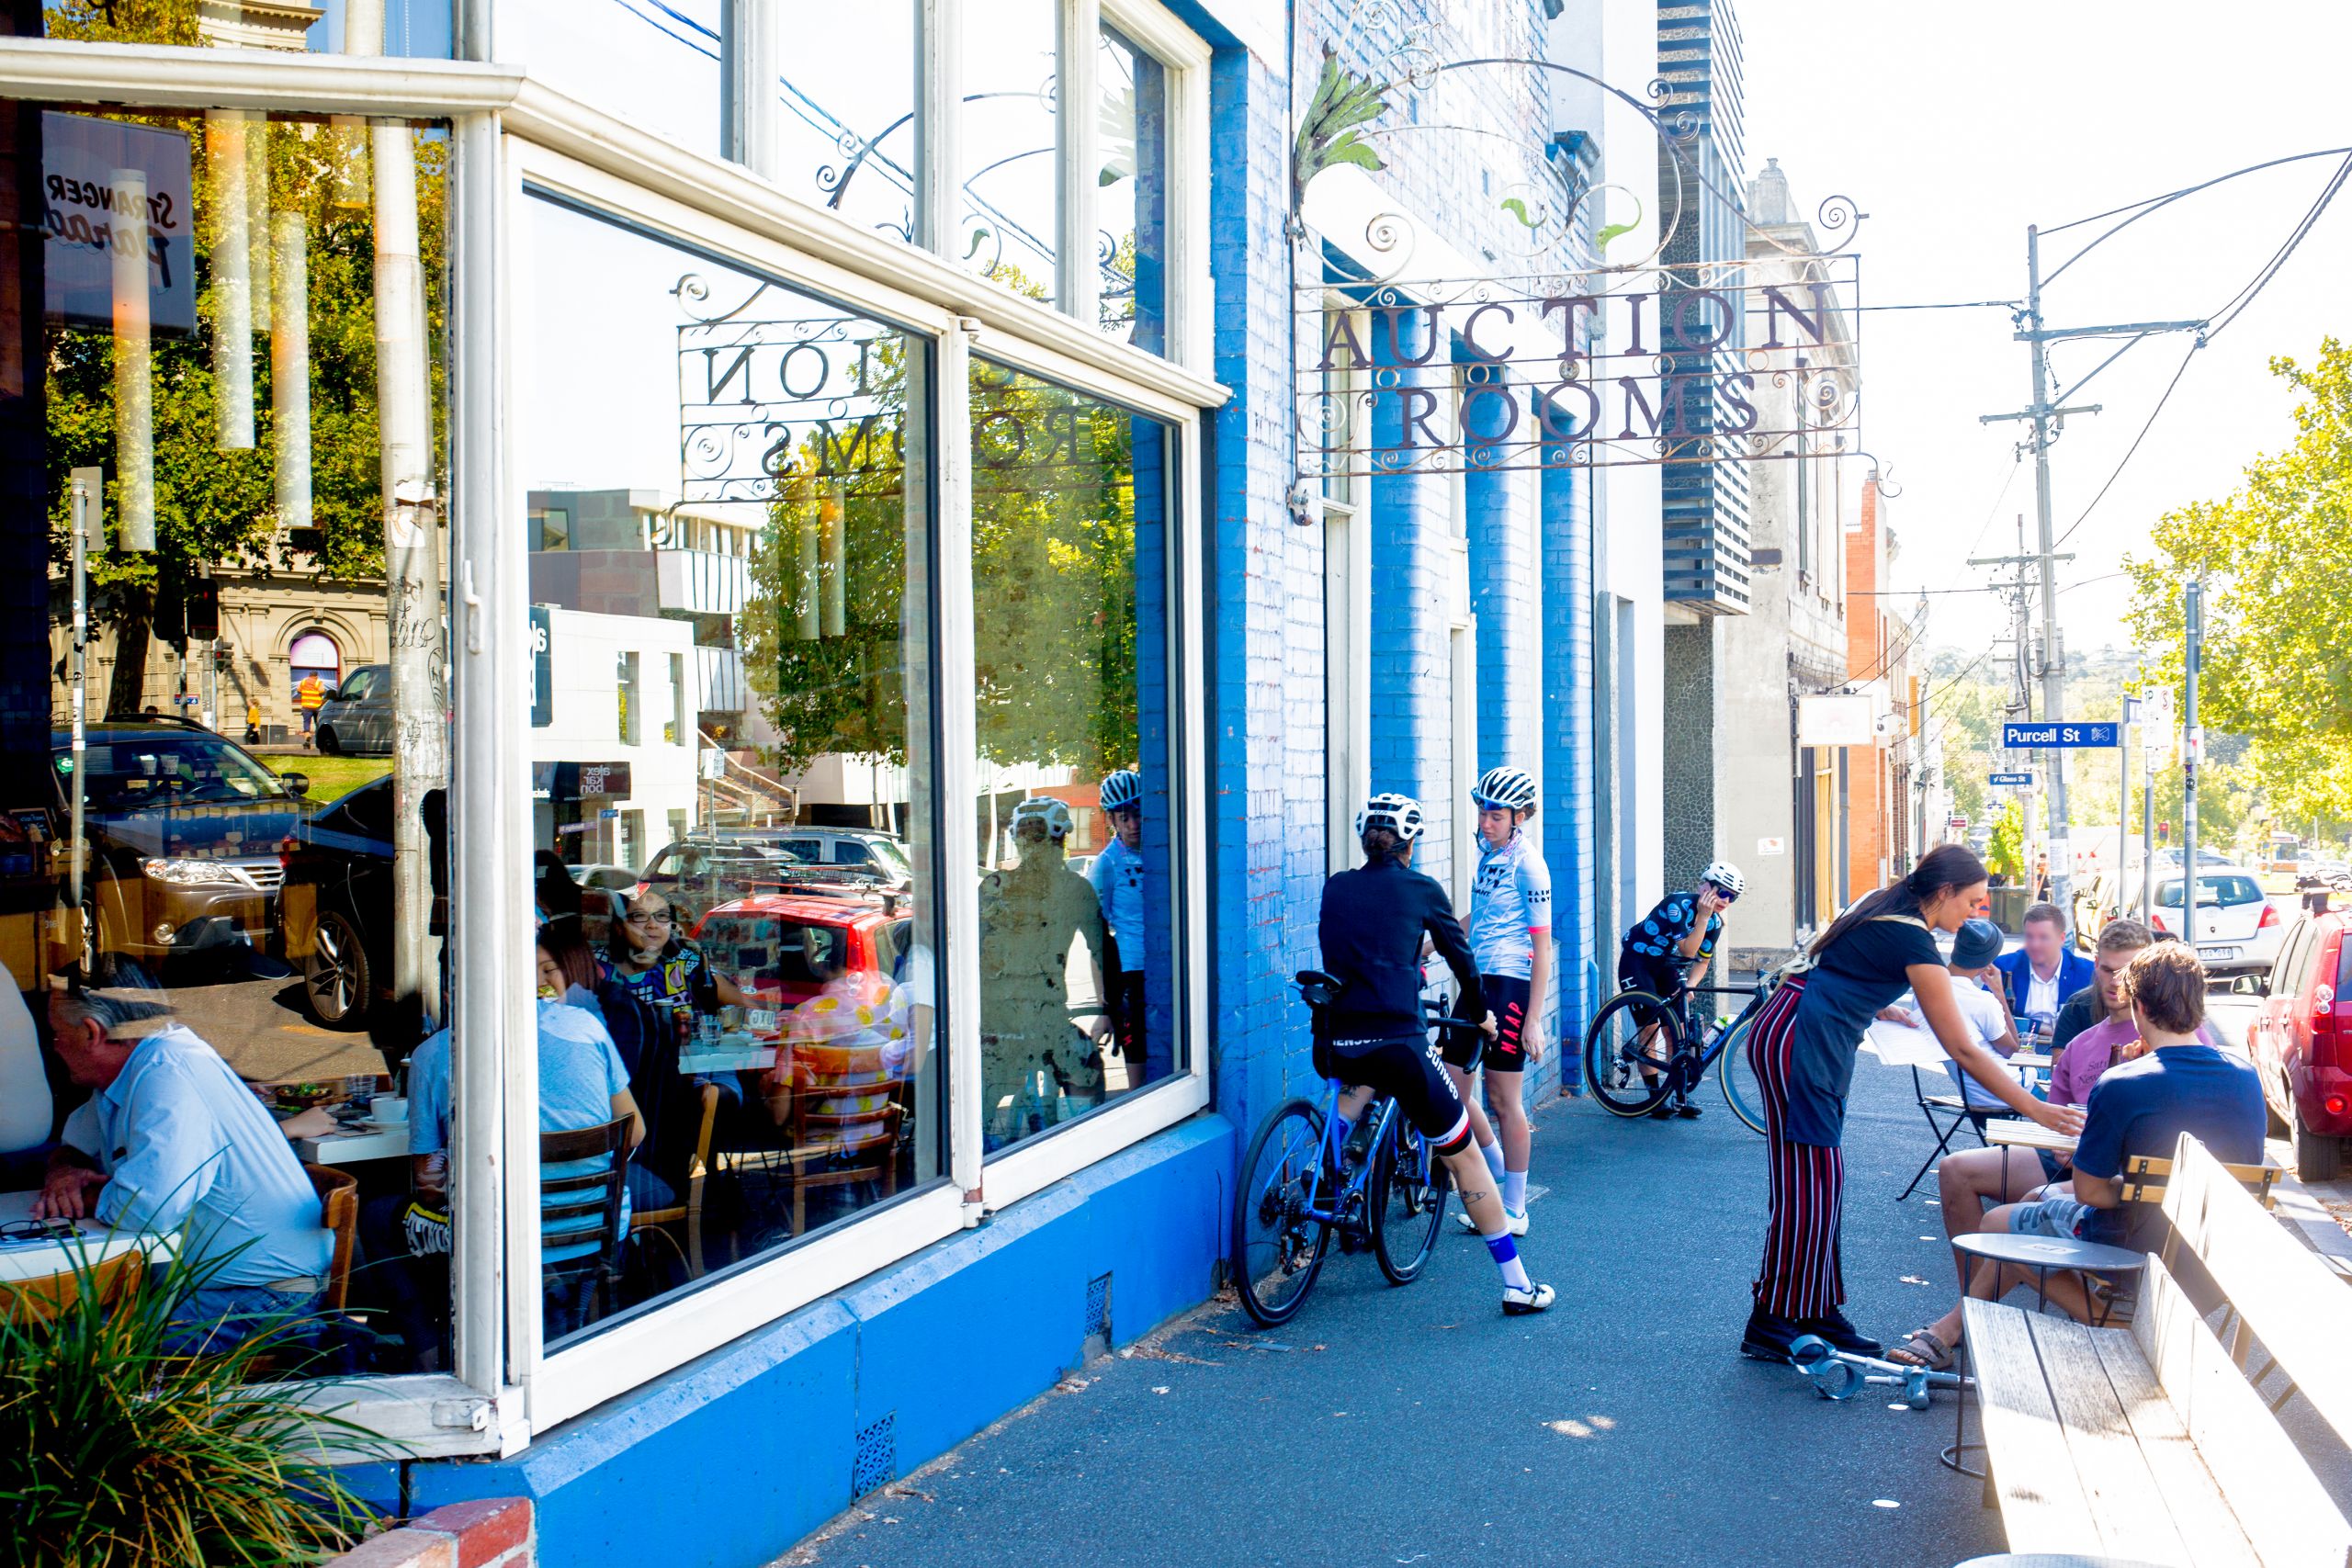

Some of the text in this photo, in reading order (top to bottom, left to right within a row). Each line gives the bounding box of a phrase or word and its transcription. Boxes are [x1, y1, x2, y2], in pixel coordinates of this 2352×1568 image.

[1317, 284, 1830, 368] AUCTION
[1399, 373, 1758, 448] ROOMS
[2007, 728, 2080, 742] Purcell St
[1500, 1001, 1524, 1055] MAAP
